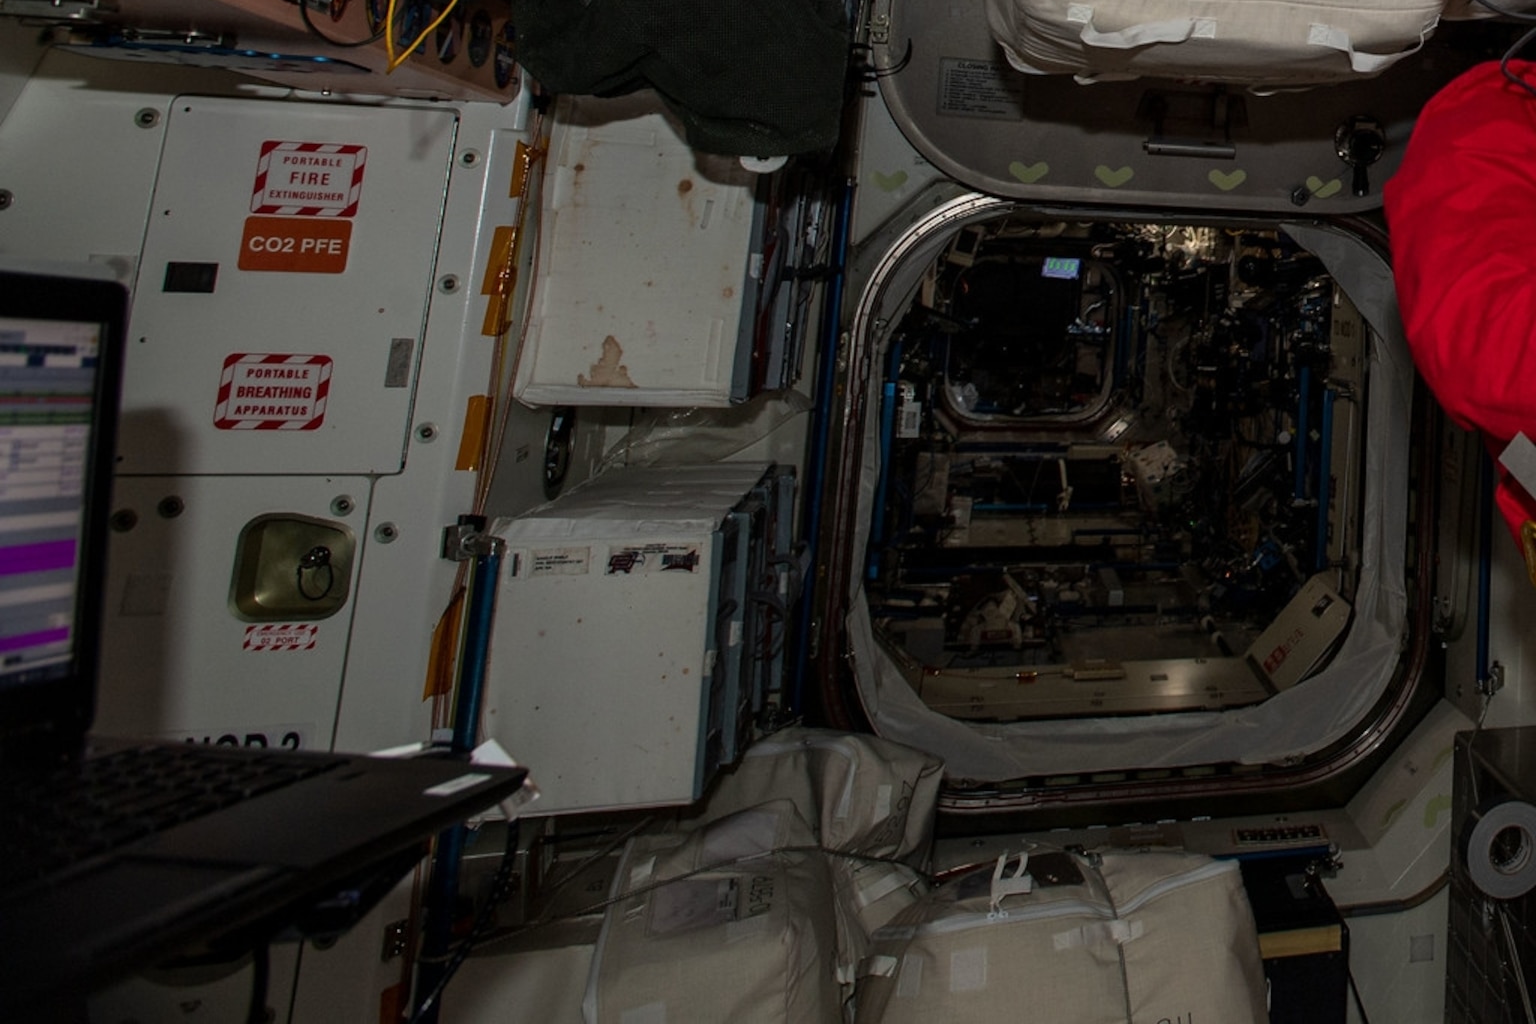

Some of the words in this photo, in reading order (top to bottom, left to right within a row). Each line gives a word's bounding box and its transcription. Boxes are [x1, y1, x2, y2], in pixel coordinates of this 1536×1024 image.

[283, 156, 343, 167] PORTABLE
[290, 172, 331, 186] FIRE
[269, 190, 344, 201] EXTINGUISHER
[248, 236, 294, 253] CO2
[300, 238, 342, 254] PFE
[246, 369, 310, 379] PORTABLE
[237, 386, 312, 399] BREATHING
[234, 405, 308, 415] APPARATUS
